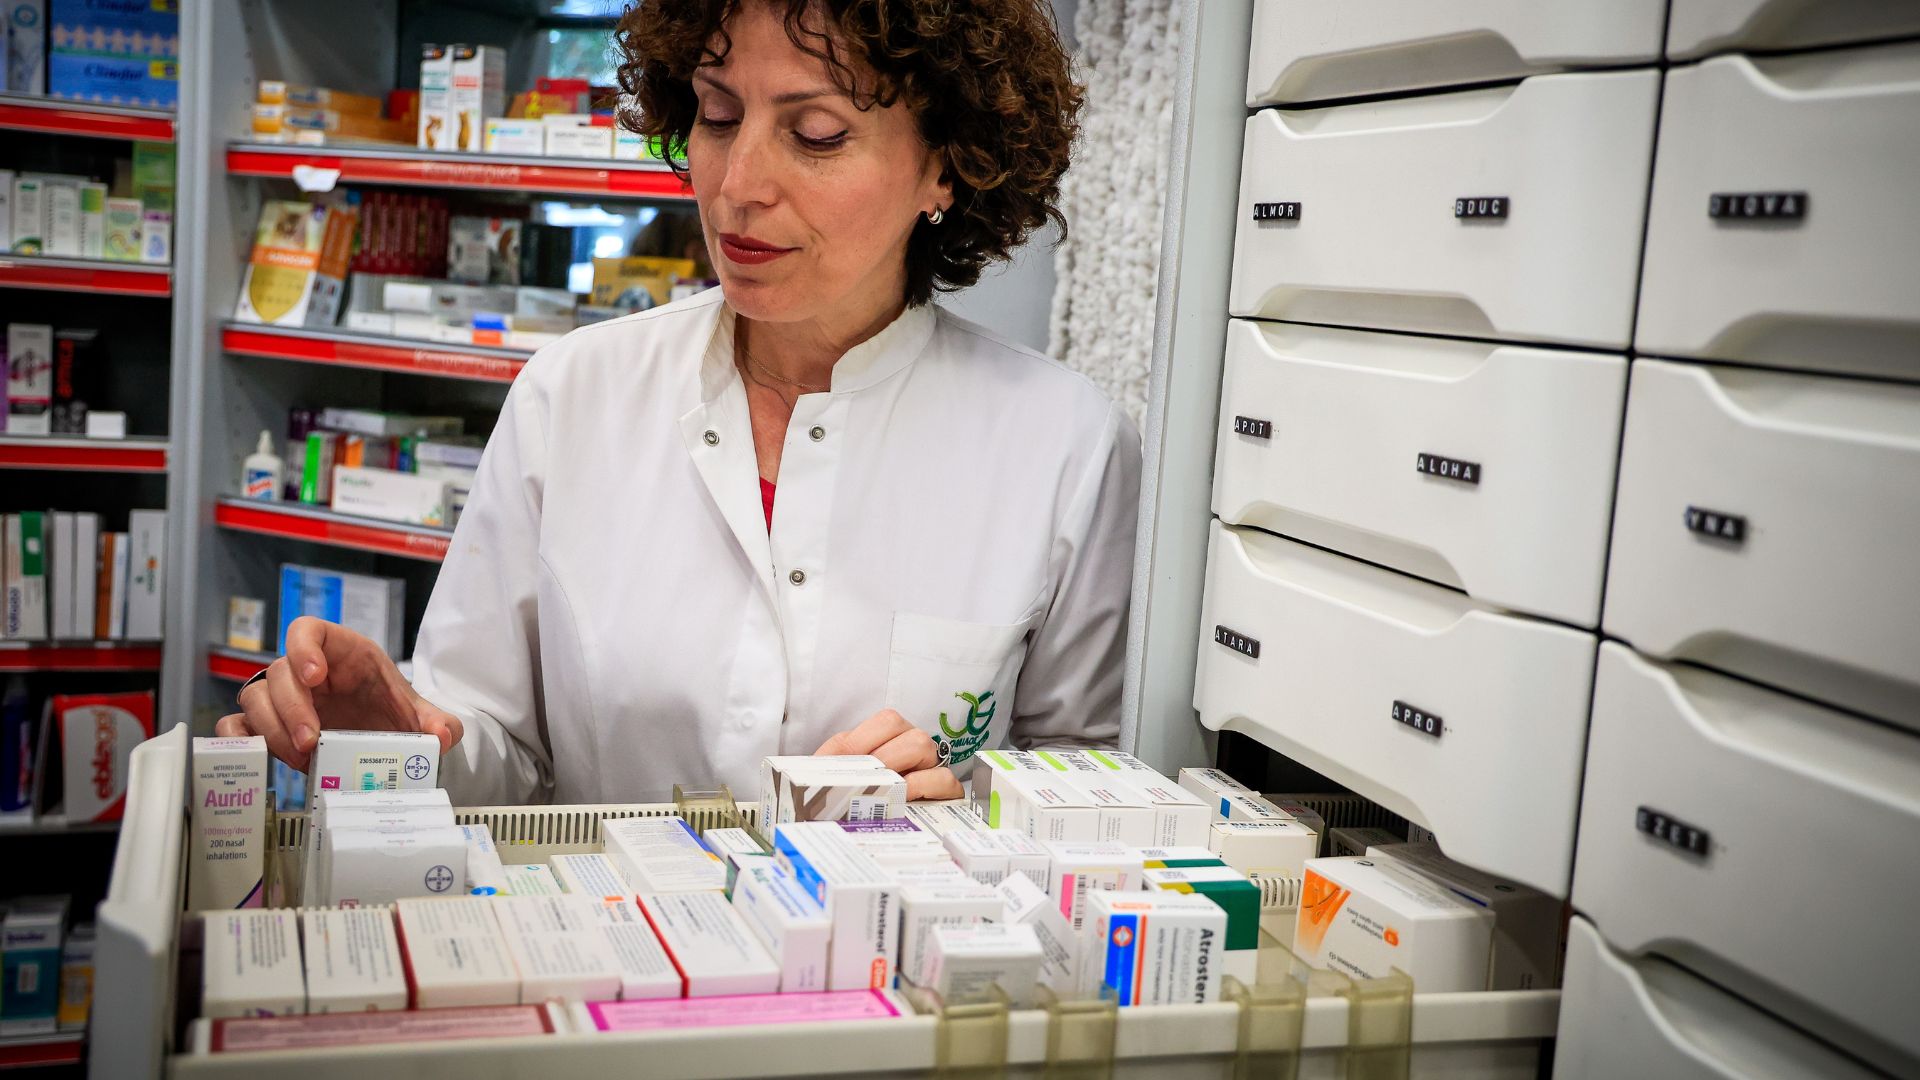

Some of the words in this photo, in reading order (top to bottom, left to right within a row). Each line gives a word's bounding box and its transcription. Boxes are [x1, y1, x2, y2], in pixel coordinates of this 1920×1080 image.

[1254, 204, 1294, 217] ALMOR
[1235, 419, 1264, 435] APOT
[1417, 456, 1471, 480] ALOHA
[1215, 629, 1252, 655] ATARA
[1393, 705, 1434, 732] APRO
[204, 787, 253, 808] Aurid
[210, 839, 224, 848] 200
[225, 837, 245, 847] nasal
[206, 851, 248, 861] inhalations
